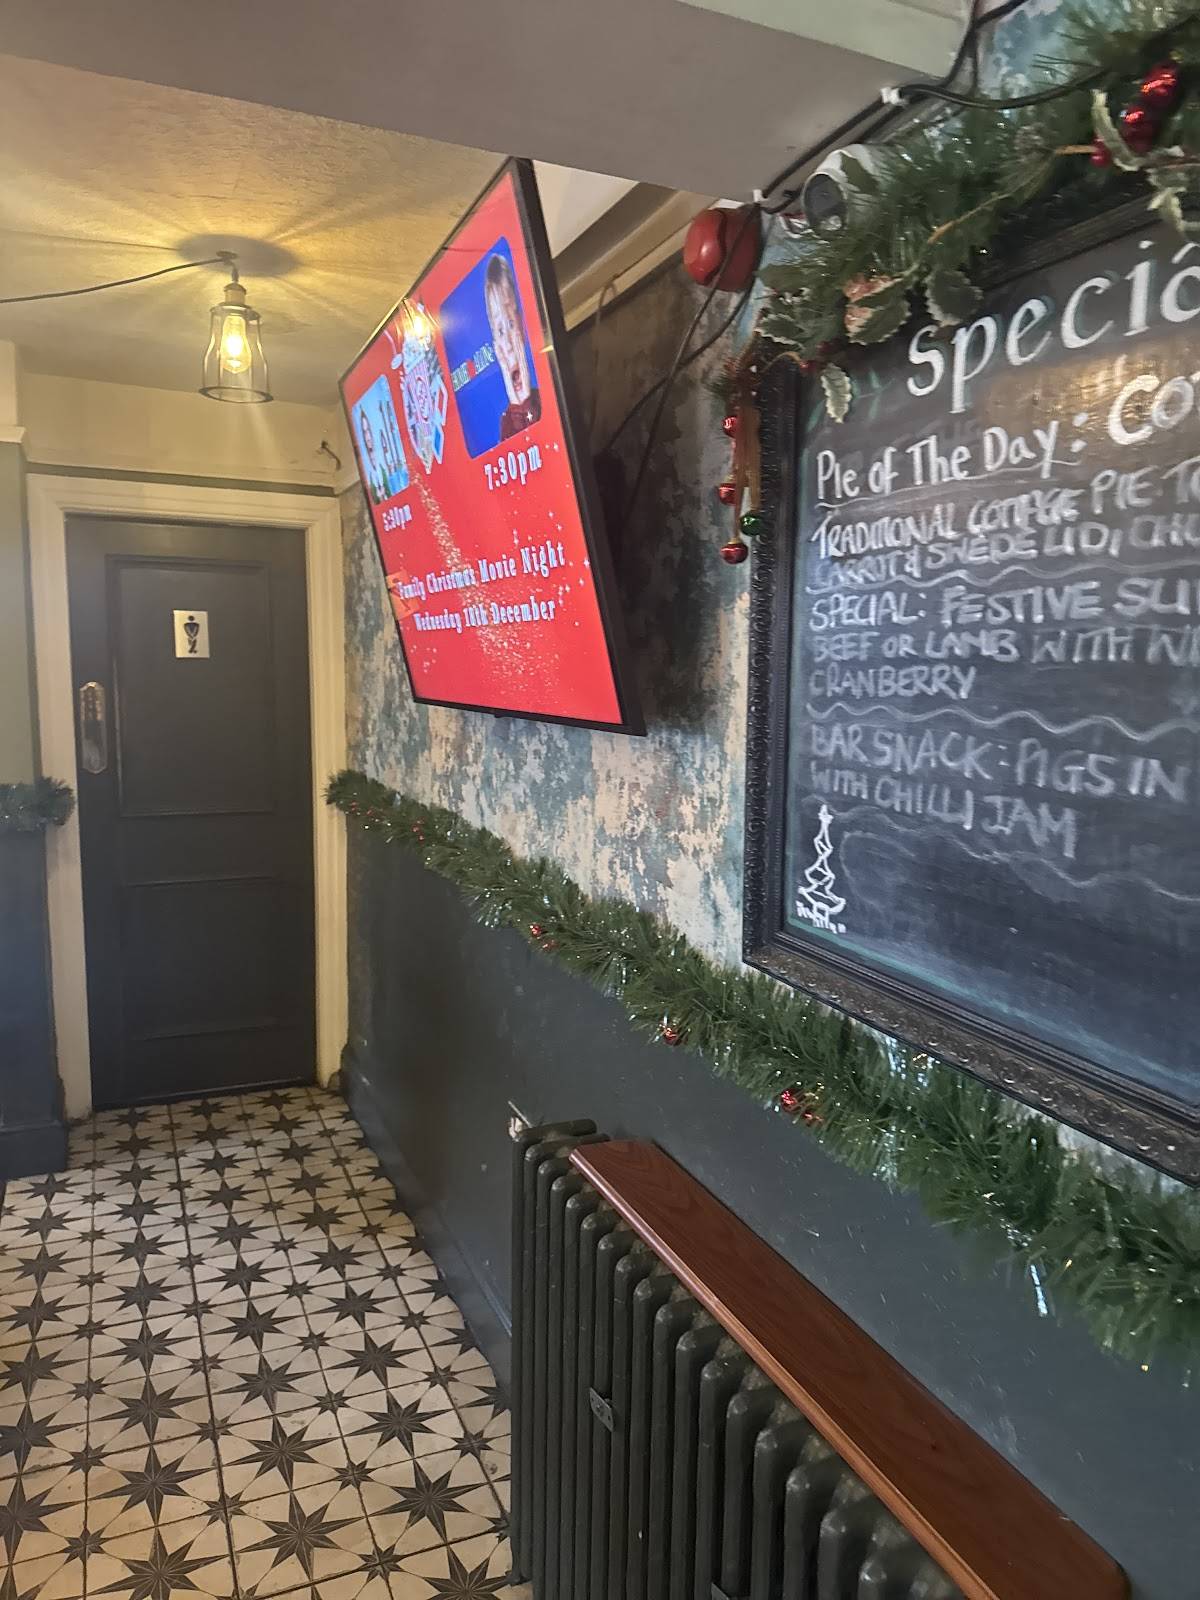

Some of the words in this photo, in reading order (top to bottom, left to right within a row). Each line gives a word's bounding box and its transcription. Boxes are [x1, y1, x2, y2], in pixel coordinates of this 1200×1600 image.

[906, 434, 972, 486] The
[1108, 374, 1200, 445] CO
[484, 443, 543, 491] 7:30pm
[1090, 465, 1159, 514] PIE
[426, 564, 476, 595] Christmas
[477, 553, 517, 583] Movie
[520, 539, 566, 578] Night
[413, 608, 463, 634] Wednesday
[490, 595, 556, 626] December
[940, 580, 1105, 629] FESTIVE
[812, 630, 881, 661] BEEF
[881, 632, 918, 657] OR
[924, 628, 1020, 663] LAMB
[1029, 625, 1135, 664] WITH
[808, 665, 977, 700] CRANBERRY
[811, 724, 870, 768] BAR
[1126, 757, 1192, 803] IN
[810, 760, 870, 801] WITH
[981, 795, 1078, 859] JAM
